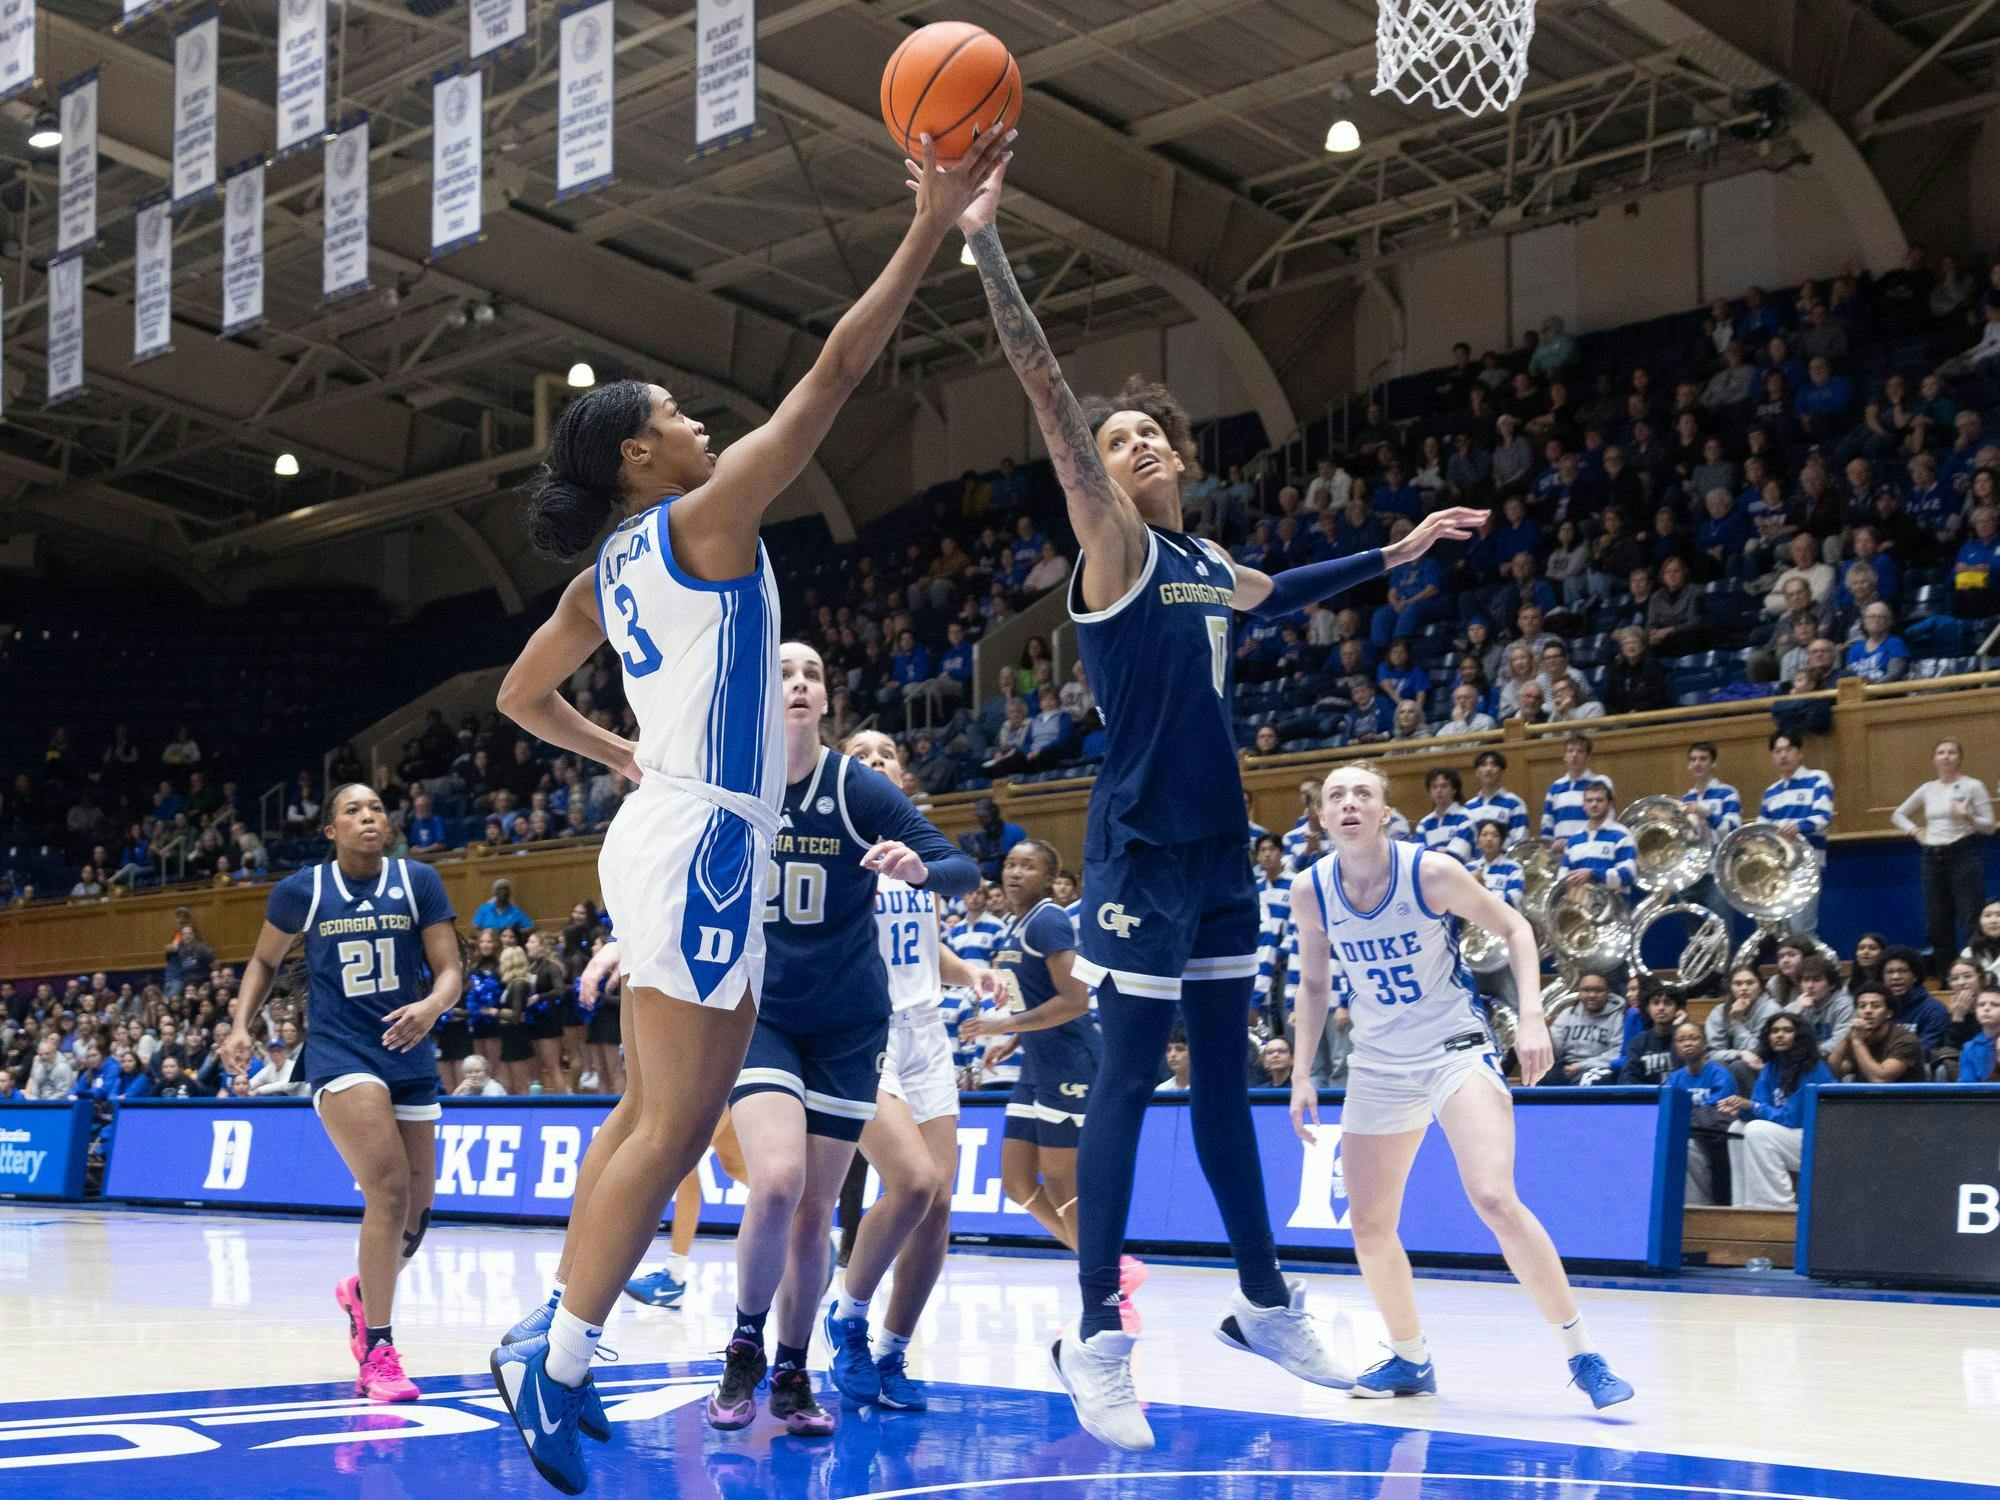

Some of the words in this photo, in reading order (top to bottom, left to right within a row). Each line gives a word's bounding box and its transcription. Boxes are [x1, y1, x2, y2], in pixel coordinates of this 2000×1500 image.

[1159, 583, 1220, 605] GEORGIA
[614, 583, 663, 678] 3
[798, 836, 841, 855] TECH
[874, 890, 934, 915] DUKE
[319, 916, 376, 937] GEORGIA
[379, 914, 411, 931] TECH
[693, 926, 733, 964] D
[890, 921, 920, 966] 12
[1340, 930, 1422, 963] DUKE
[338, 937, 400, 998] 21
[1366, 963, 1423, 1005] 35
